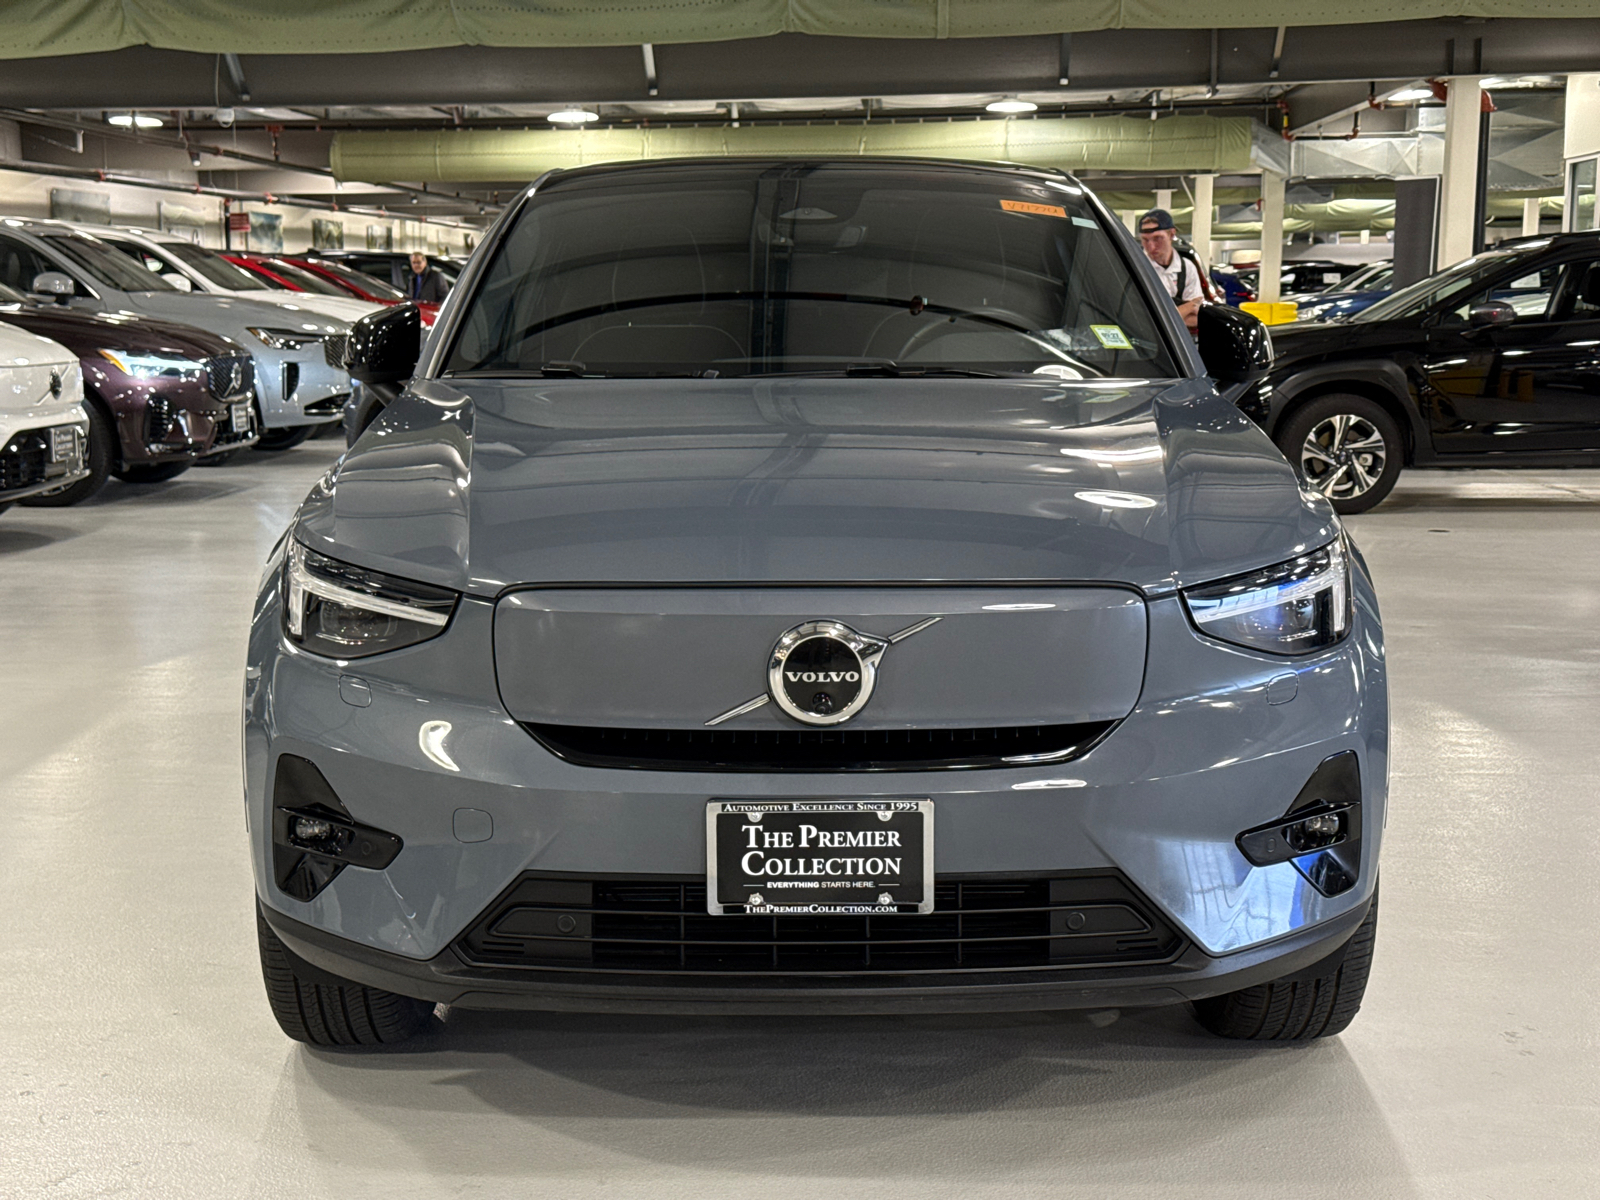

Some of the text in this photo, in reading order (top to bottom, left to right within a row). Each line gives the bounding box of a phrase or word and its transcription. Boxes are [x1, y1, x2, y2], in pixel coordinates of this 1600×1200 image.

[785, 671, 860, 682] VOLVO
[890, 802, 917, 811] 1995
[767, 881, 820, 889] EVERYTHING
